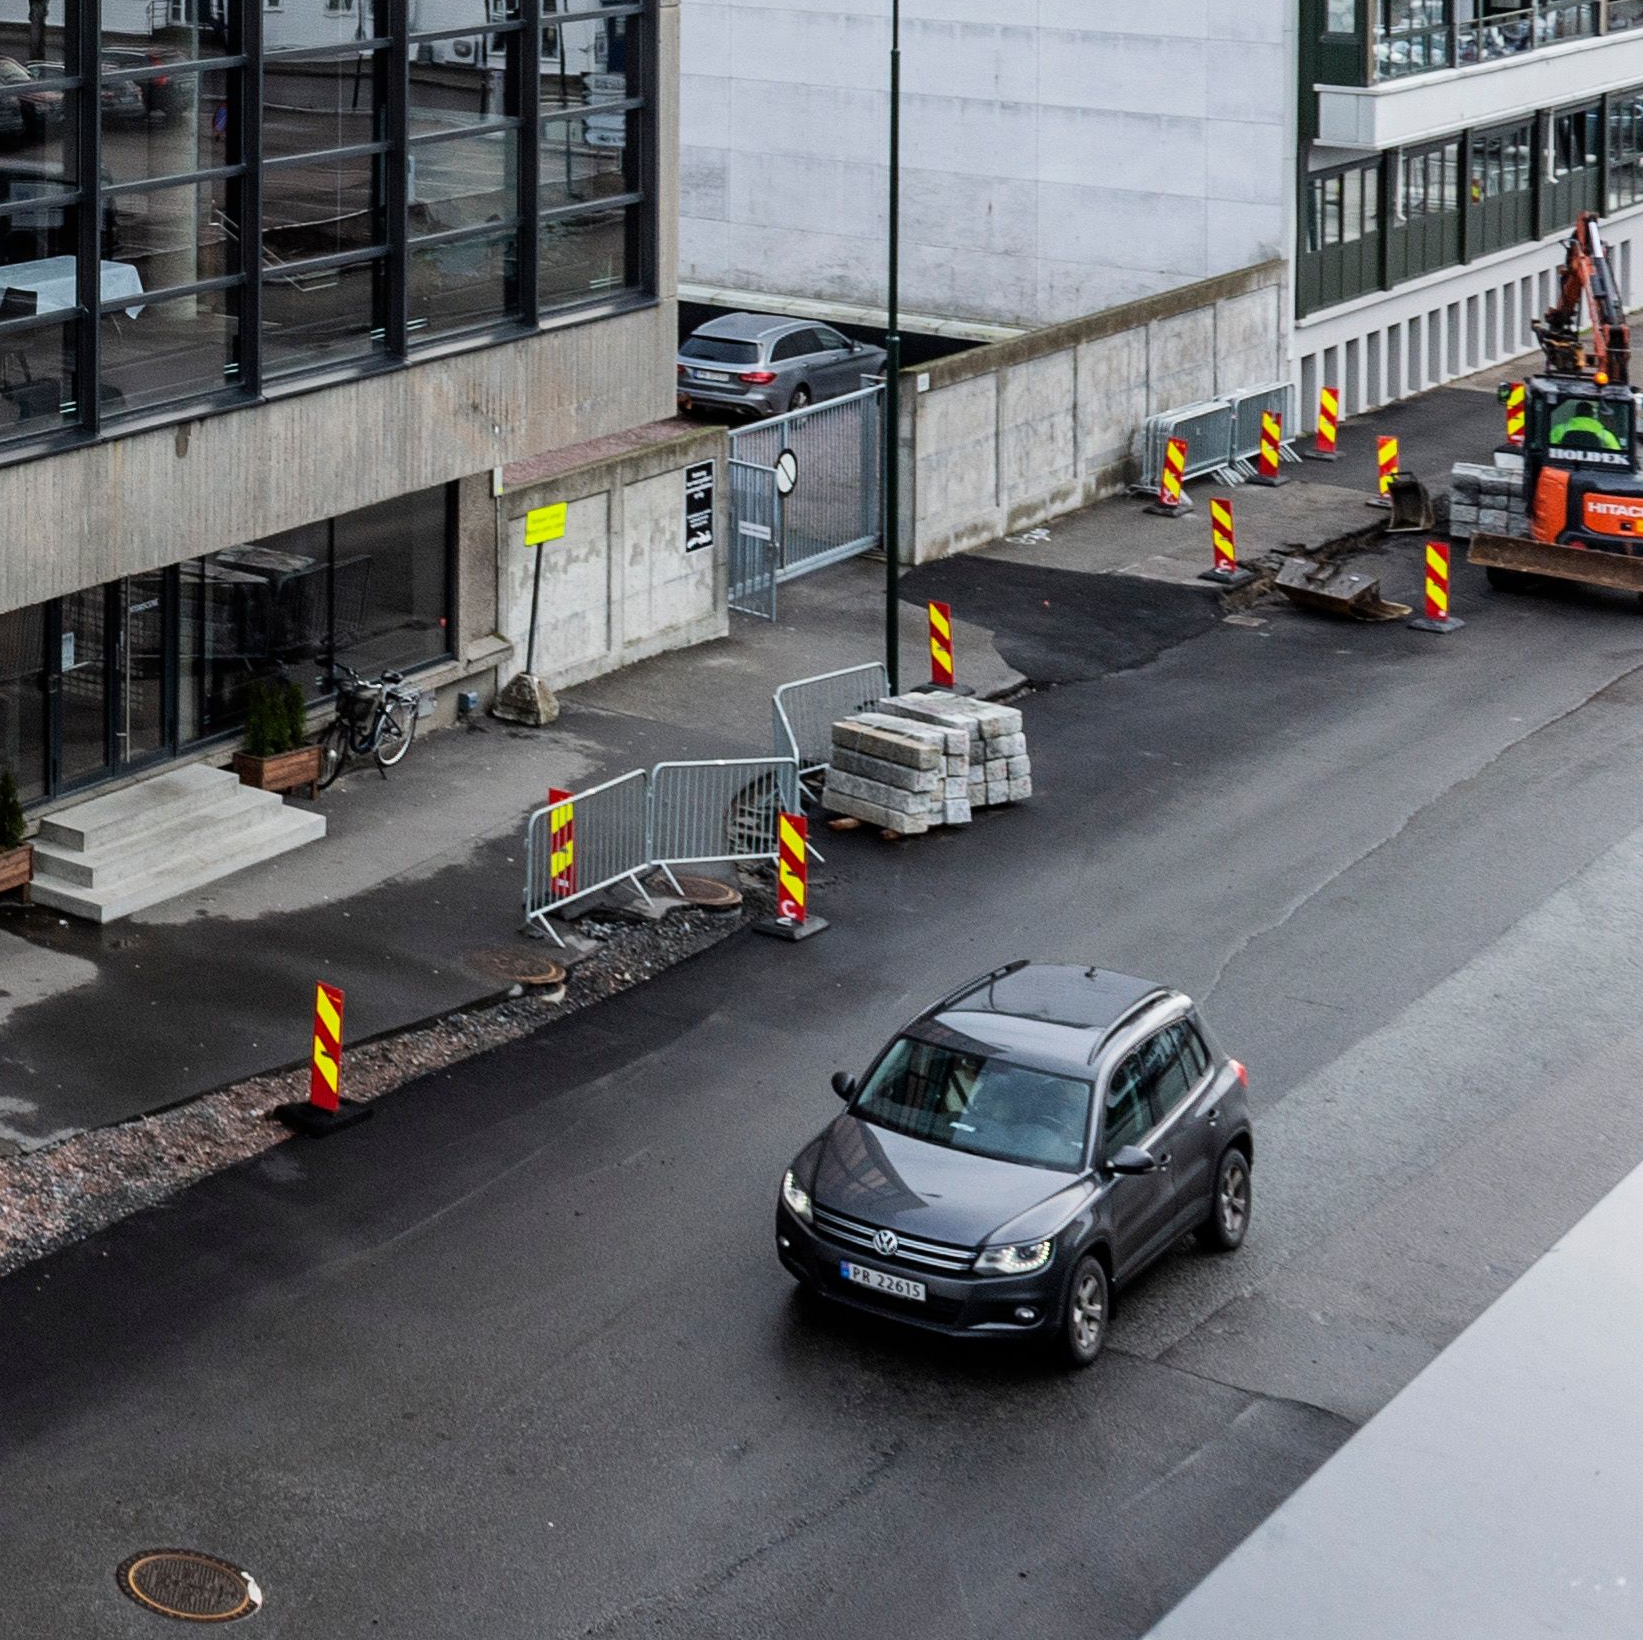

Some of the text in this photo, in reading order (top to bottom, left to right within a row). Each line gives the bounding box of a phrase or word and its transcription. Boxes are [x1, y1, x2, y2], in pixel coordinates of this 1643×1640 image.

[1549, 448, 1630, 465] HOLBEK
[1587, 502, 1643, 517] HITAC
[852, 1266, 921, 1298] PR 22615
